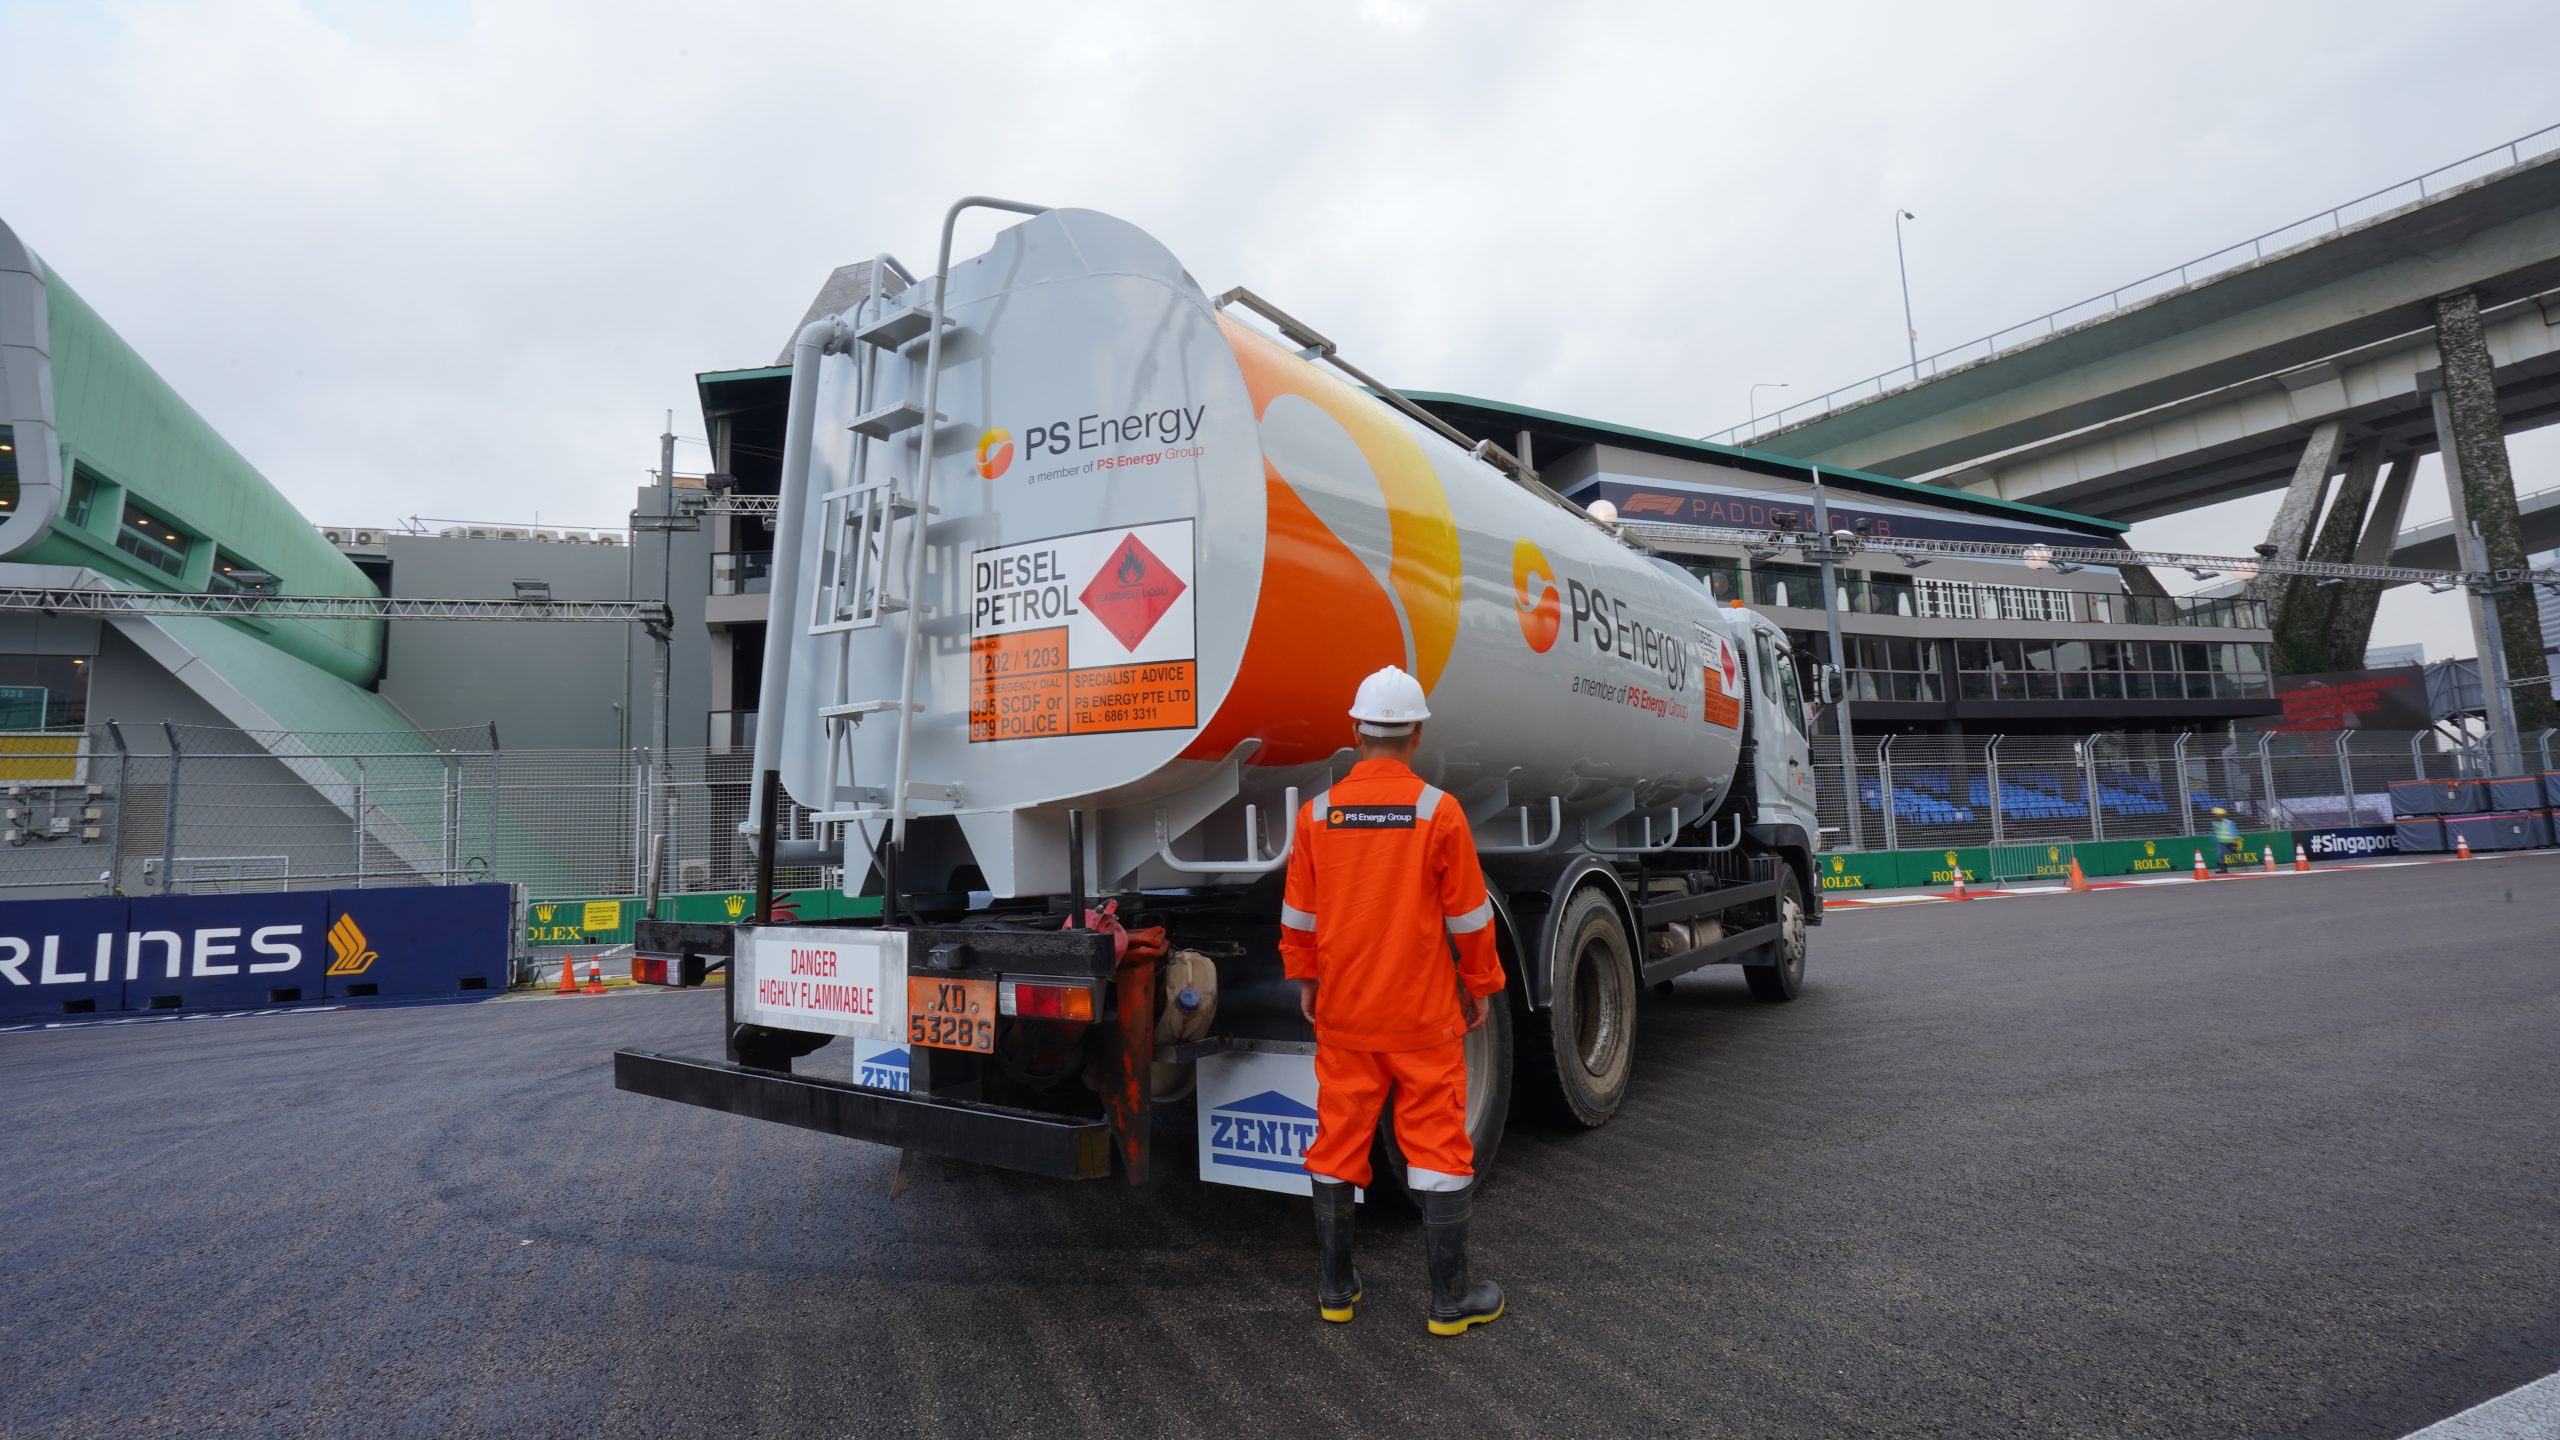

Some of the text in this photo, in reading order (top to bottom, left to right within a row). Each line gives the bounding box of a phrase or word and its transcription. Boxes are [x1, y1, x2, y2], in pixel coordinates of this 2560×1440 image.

[1026, 404, 1206, 461] PS Energy
[1028, 445, 1205, 485] a member of PS Energy Group
[1829, 514, 1891, 537] CLB
[976, 549, 1067, 594] DIESEL
[975, 584, 1079, 629] PETROL
[1567, 577, 1687, 692] PS Energy
[977, 652, 1009, 674] 1202
[1023, 646, 1060, 670] 1203
[983, 680, 1038, 695] EMERGENCY
[1040, 678, 1061, 689] DIAL
[1075, 666, 1184, 688] SPECIALIST ADVICE
[973, 693, 1062, 717] 995 SCDF or
[1075, 689, 1190, 709] PS ENERGY PTE LTD
[1572, 676, 1579, 692] a
[1581, 678, 1616, 700] member
[1617, 685, 1627, 703] of
[1627, 686, 1640, 707] PS
[1640, 690, 1667, 718] Energy
[1668, 698, 1688, 719] Group
[973, 713, 1057, 737] 999 POLICE
[1075, 711, 1096, 724] TEL
[1104, 708, 1129, 722] 6861
[1132, 707, 1157, 720] 3311
[1345, 813, 1412, 823] PS Energy Group
[2311, 833, 2399, 854] #Singapore
[1932, 870, 1974, 882] ROLX
[2134, 858, 2170, 870] ROLEX
[527, 926, 582, 940] OLEX
[791, 949, 837, 978] DANGER
[759, 978, 874, 1016] HIGHLY FLAMMABLE
[937, 984, 966, 1013] XD
[912, 1014, 992, 1050] 5328S
[1211, 1114, 1319, 1159] ZENIT
